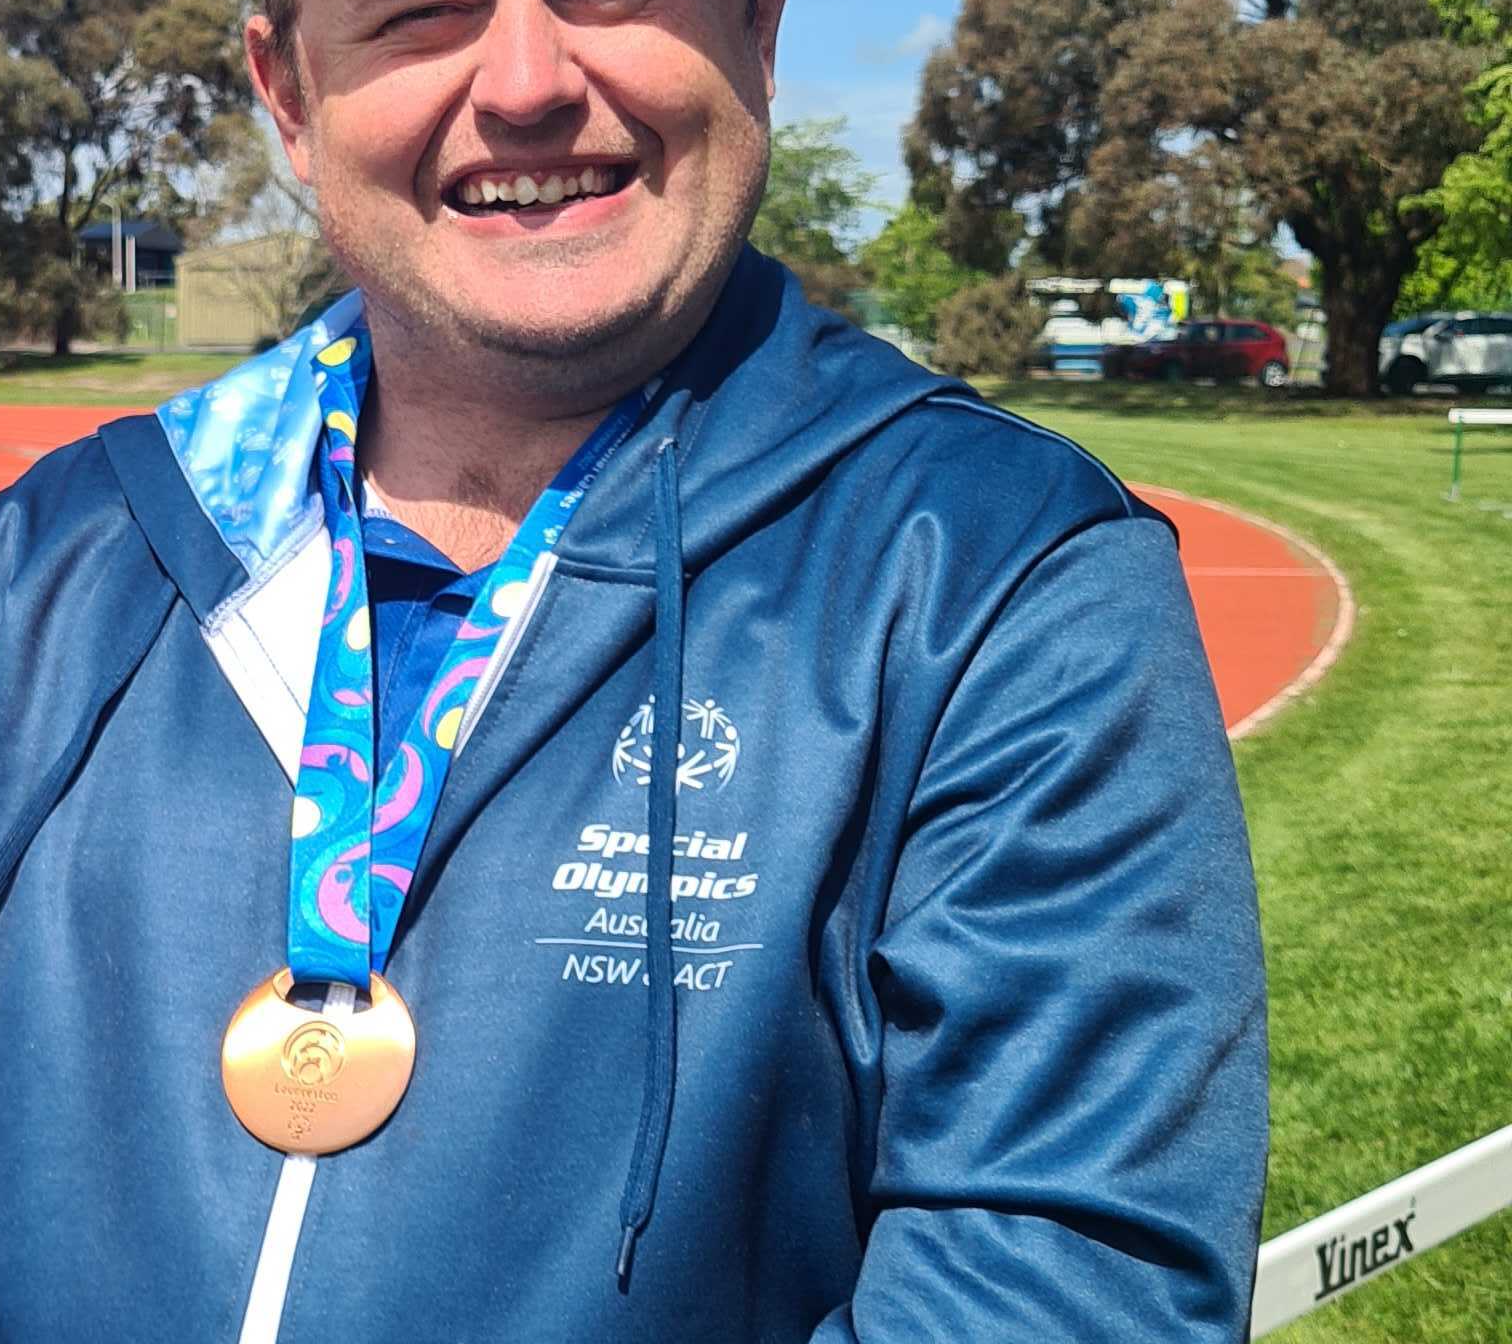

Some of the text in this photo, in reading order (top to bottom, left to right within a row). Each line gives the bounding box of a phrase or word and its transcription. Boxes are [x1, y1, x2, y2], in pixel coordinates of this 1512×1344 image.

[577, 824, 748, 860] Special
[584, 907, 720, 943] Ausalia
[561, 954, 641, 985] NSW
[673, 960, 734, 991] ACT
[1314, 1211, 1416, 1302] Vinex
